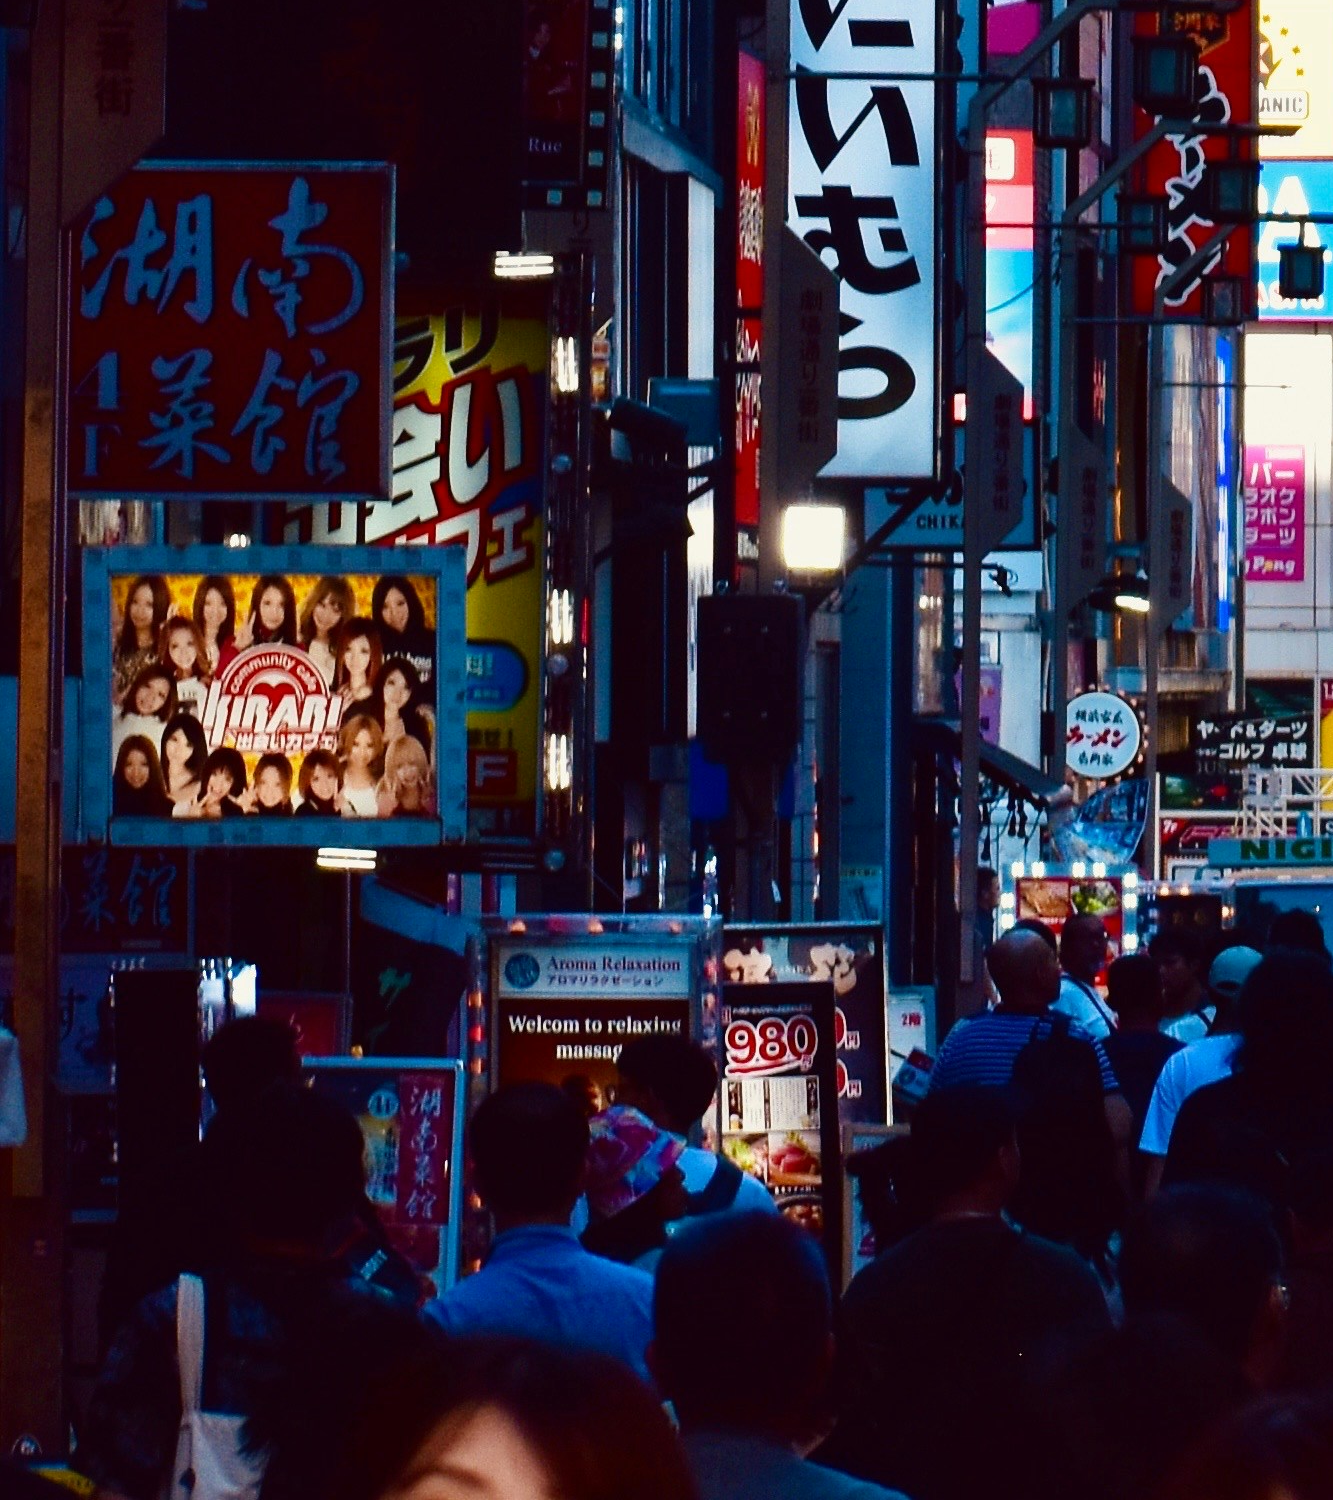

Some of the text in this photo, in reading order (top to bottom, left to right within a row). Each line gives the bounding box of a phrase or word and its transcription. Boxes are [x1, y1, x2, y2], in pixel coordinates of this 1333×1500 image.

[230, 652, 297, 696] community
[1218, 743, 1308, 760] ゴルフ 卓球
[547, 955, 681, 973] Aroma Relaxation
[508, 1013, 682, 1036] Welcom to relaxing
[726, 1016, 818, 1064] 980
